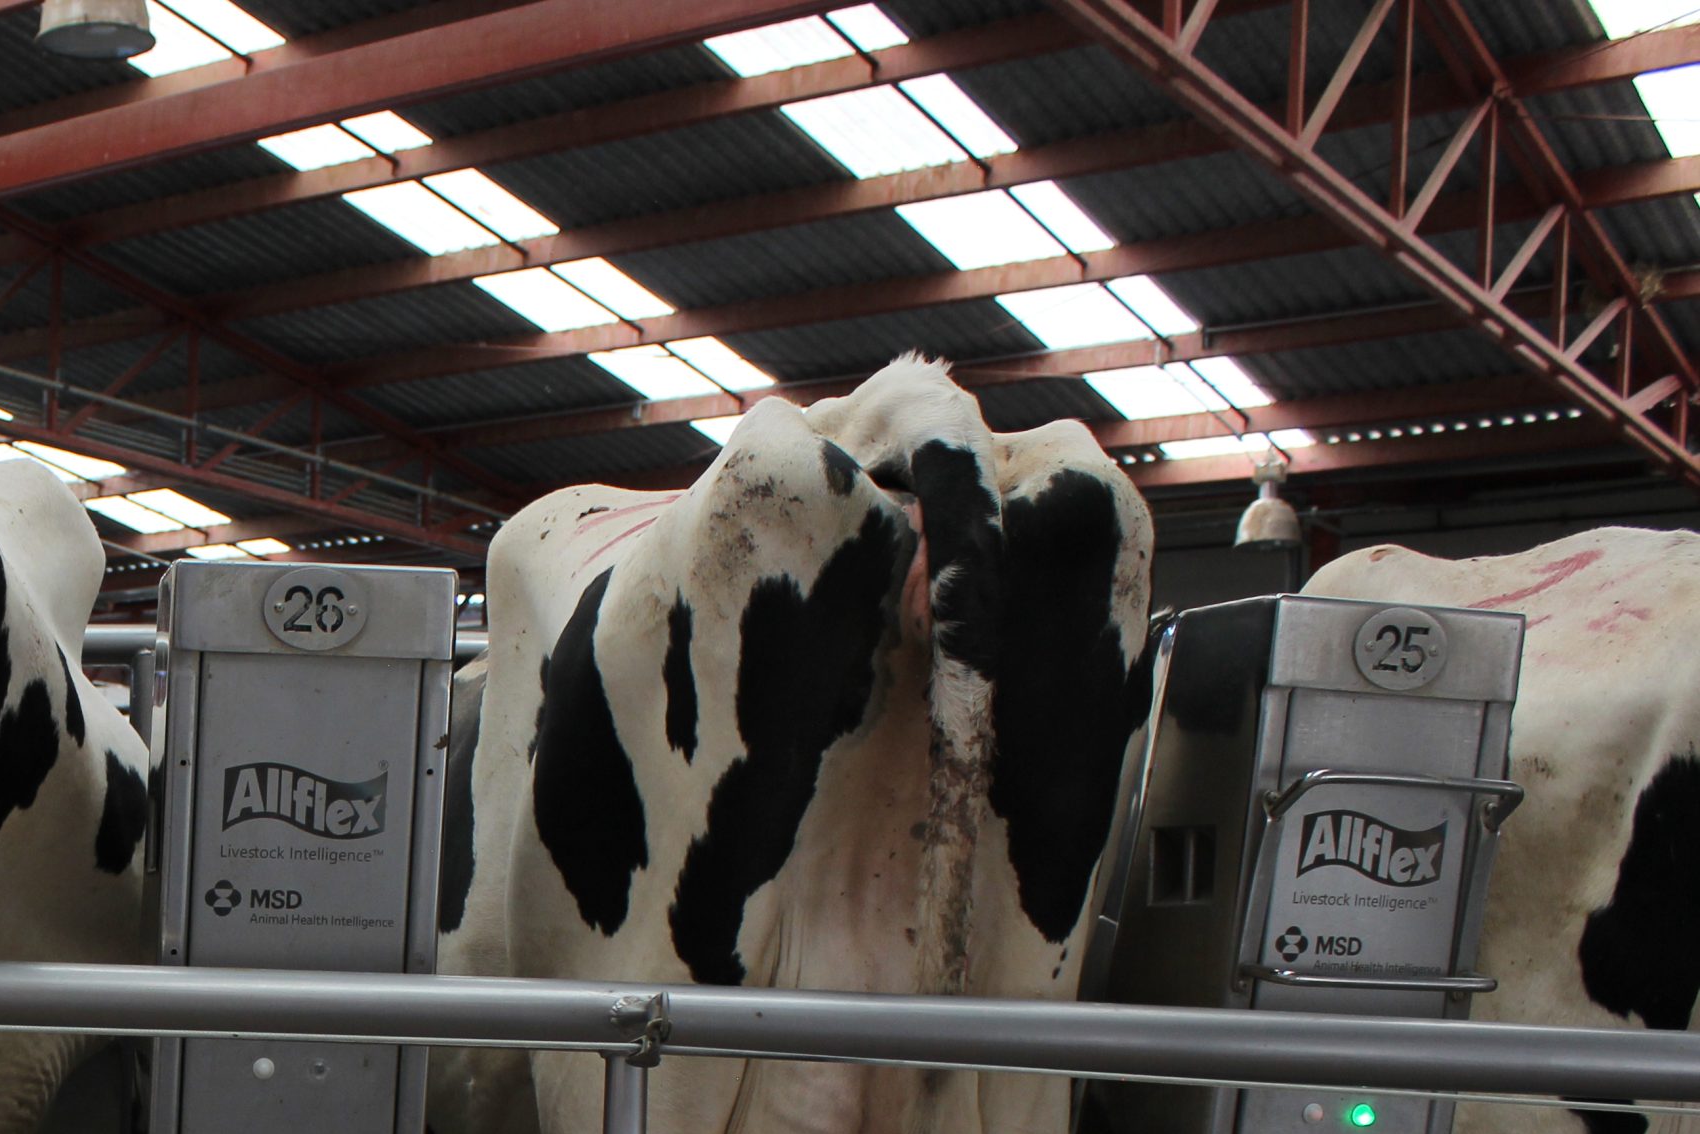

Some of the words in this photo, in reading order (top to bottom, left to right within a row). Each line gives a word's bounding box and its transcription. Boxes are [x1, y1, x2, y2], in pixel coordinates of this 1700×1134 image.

[283, 586, 344, 633] 26
[1372, 624, 1430, 673] 25
[220, 844, 284, 860] Livestock
[250, 889, 303, 909] MSD
[1293, 891, 1350, 906] Livestock
[250, 912, 289, 925] Animal
[291, 914, 329, 926] Health
[331, 915, 395, 929] Intelligence
[1315, 936, 1362, 956] MSD
[1314, 960, 1349, 972] Animal
[1350, 961, 1383, 974] Health
[1385, 963, 1443, 977] Intelligence
